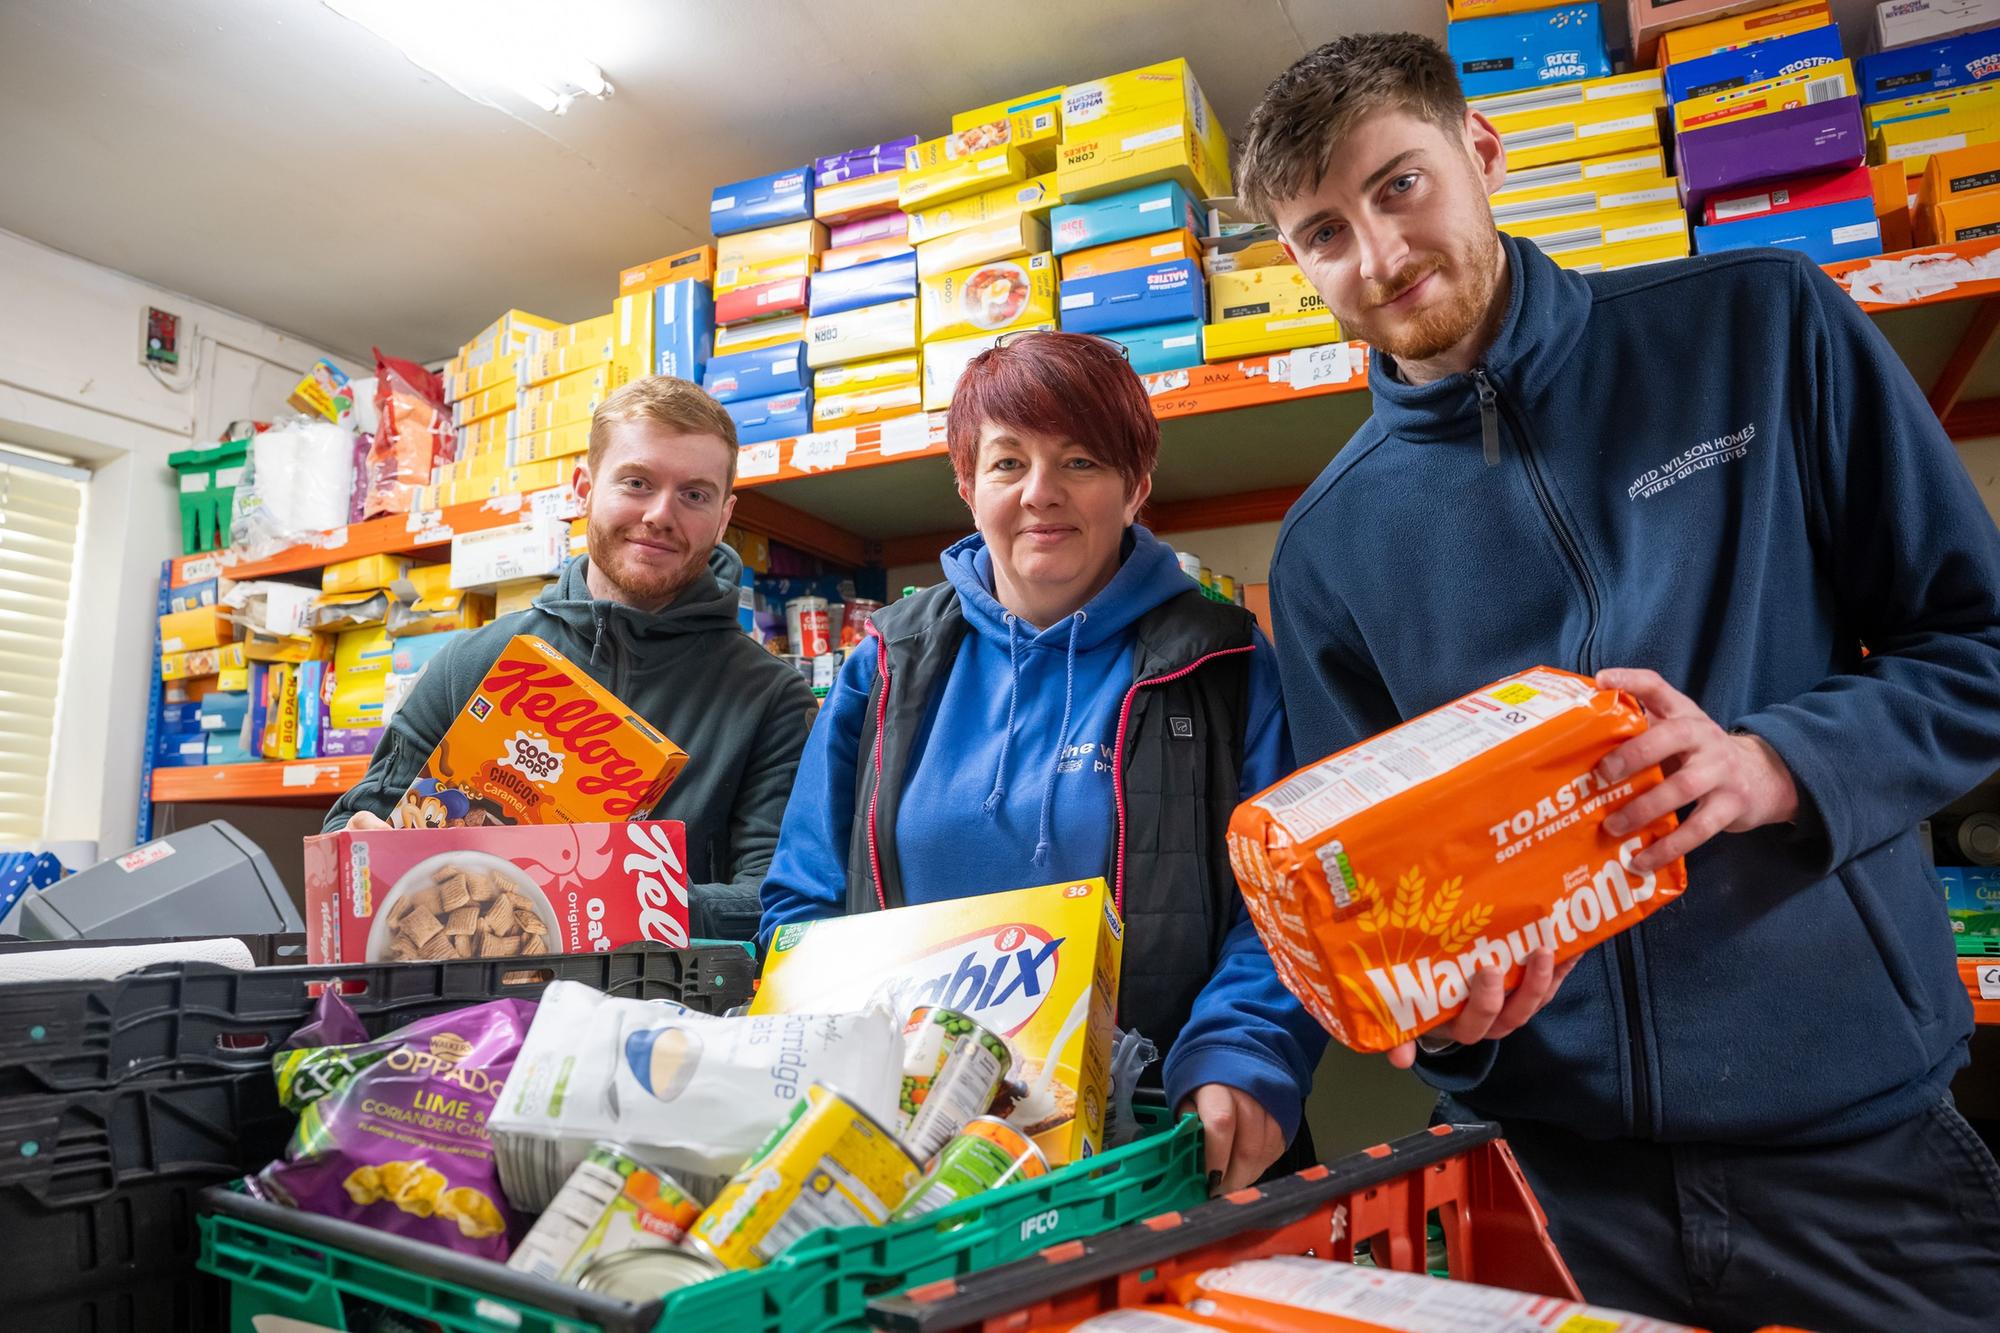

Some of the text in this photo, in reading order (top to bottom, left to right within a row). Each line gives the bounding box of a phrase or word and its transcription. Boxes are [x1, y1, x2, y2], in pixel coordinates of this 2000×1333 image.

[1545, 52, 1579, 66] RICE
[1779, 56, 1834, 75] FROSTED
[1965, 53, 2000, 72] FROS
[1539, 63, 1587, 80] SNAPS
[1067, 97, 1103, 114] WHEAT
[1064, 142, 1099, 158] FLAKES
[1068, 151, 1095, 165] CORN
[1300, 294, 1325, 308] COR
[814, 327, 838, 343] CORN
[1309, 349, 1337, 363] FEB
[1203, 374, 1230, 384] MAX
[1312, 364, 1333, 381] 23
[1628, 422, 1756, 498] DAVID WILSON HOMES
[1642, 477, 1676, 498] WHERE
[1720, 446, 1747, 463] LIVES
[282, 678, 297, 743] BIG PACK
[514, 754, 549, 777] pops
[483, 782, 526, 813] Caramel
[489, 767, 540, 807] CHOCOS
[555, 808, 570, 821] HIGH
[1489, 772, 1630, 846] TOASTI
[1495, 783, 1633, 864] SOFT THICK WHITE
[624, 823, 689, 949] Kel
[1067, 885, 1089, 898] 36
[567, 891, 582, 952] Original
[1366, 836, 1657, 1032] Warburtons
[386, 1048, 505, 1098] OPPADO
[361, 1098, 456, 1132] CORIANDER
[413, 1089, 471, 1120] LIME
[1021, 1209, 1058, 1241] IFCO
